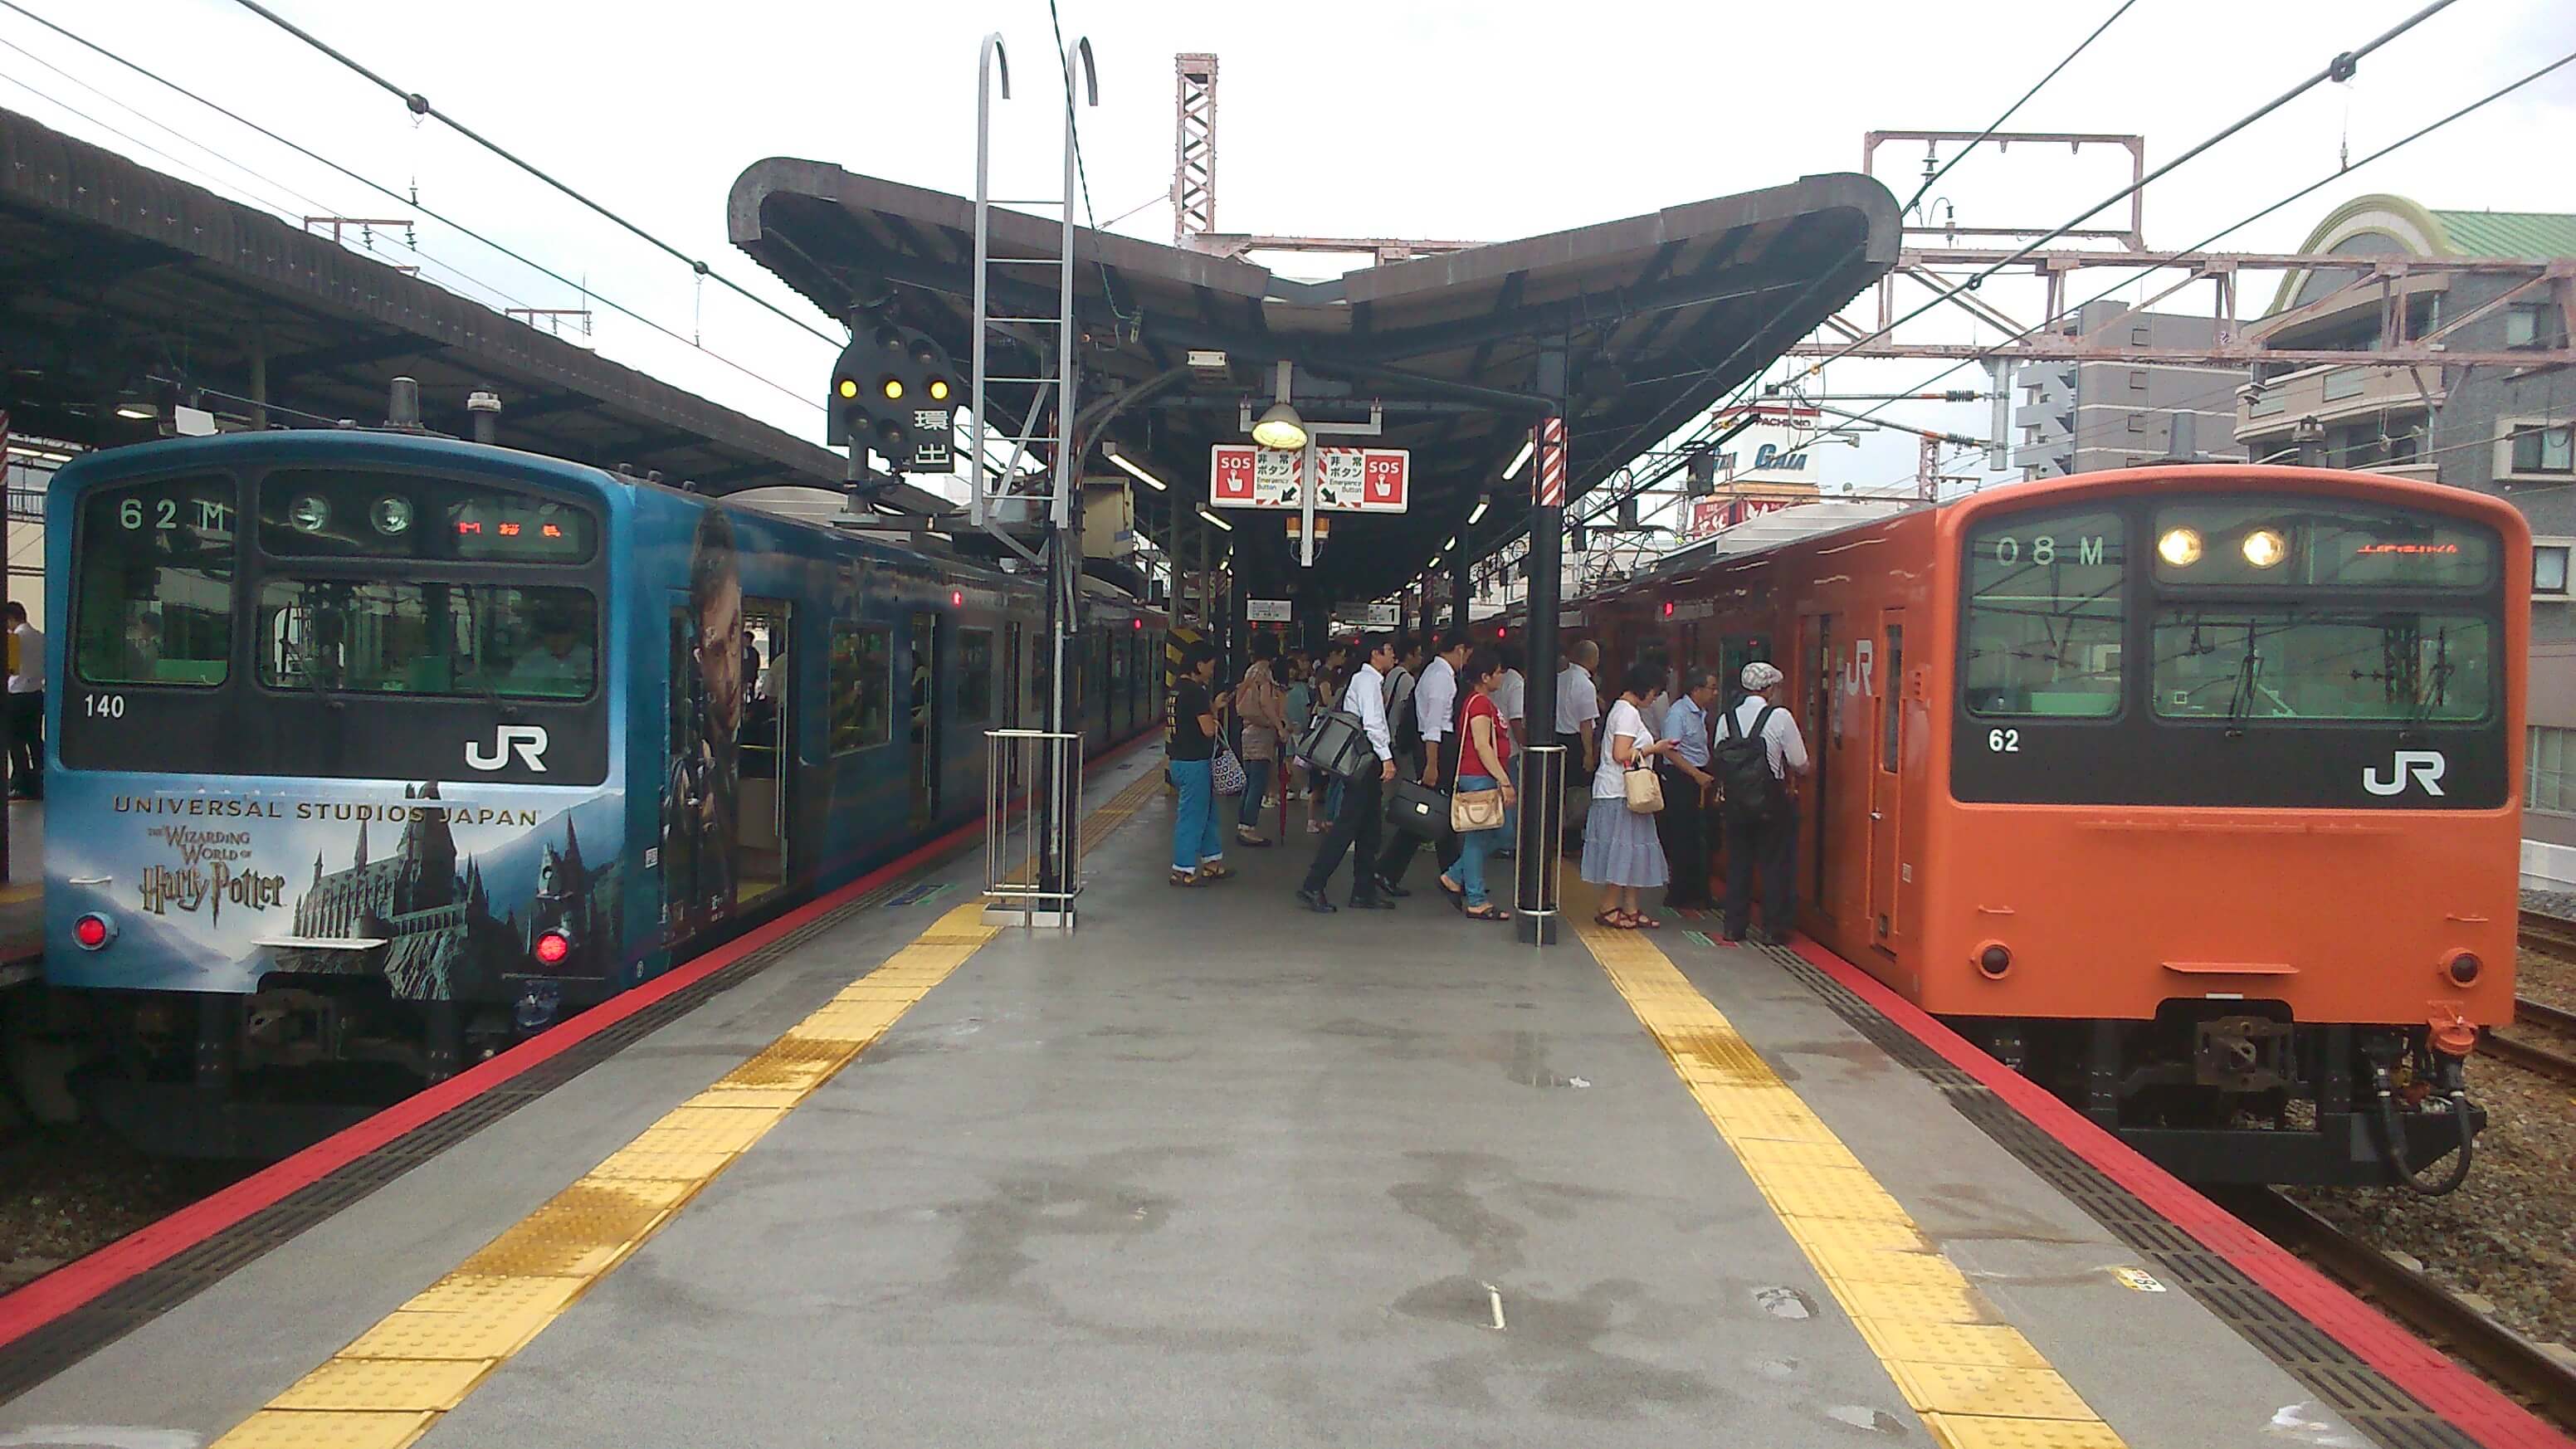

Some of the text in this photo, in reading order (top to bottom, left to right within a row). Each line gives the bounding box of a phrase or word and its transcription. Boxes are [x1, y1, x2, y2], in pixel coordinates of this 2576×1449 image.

[1221, 457, 1251, 469] SOS
[1257, 466, 1289, 476] ボタン
[1330, 467, 1362, 477] ボタン
[1369, 461, 1399, 474] SOS
[1388, 608, 1395, 622] 1
[1845, 640, 1873, 696] JR
[85, 695, 125, 719] 140
[466, 724, 549, 773] JR
[1989, 729, 2019, 752] 62
[2364, 751, 2445, 796] JR
[115, 796, 539, 827] UNIVERSAL STUDIOS JAPAN
[178, 844, 238, 865] WORLD
[139, 861, 285, 929] Harry Potter
